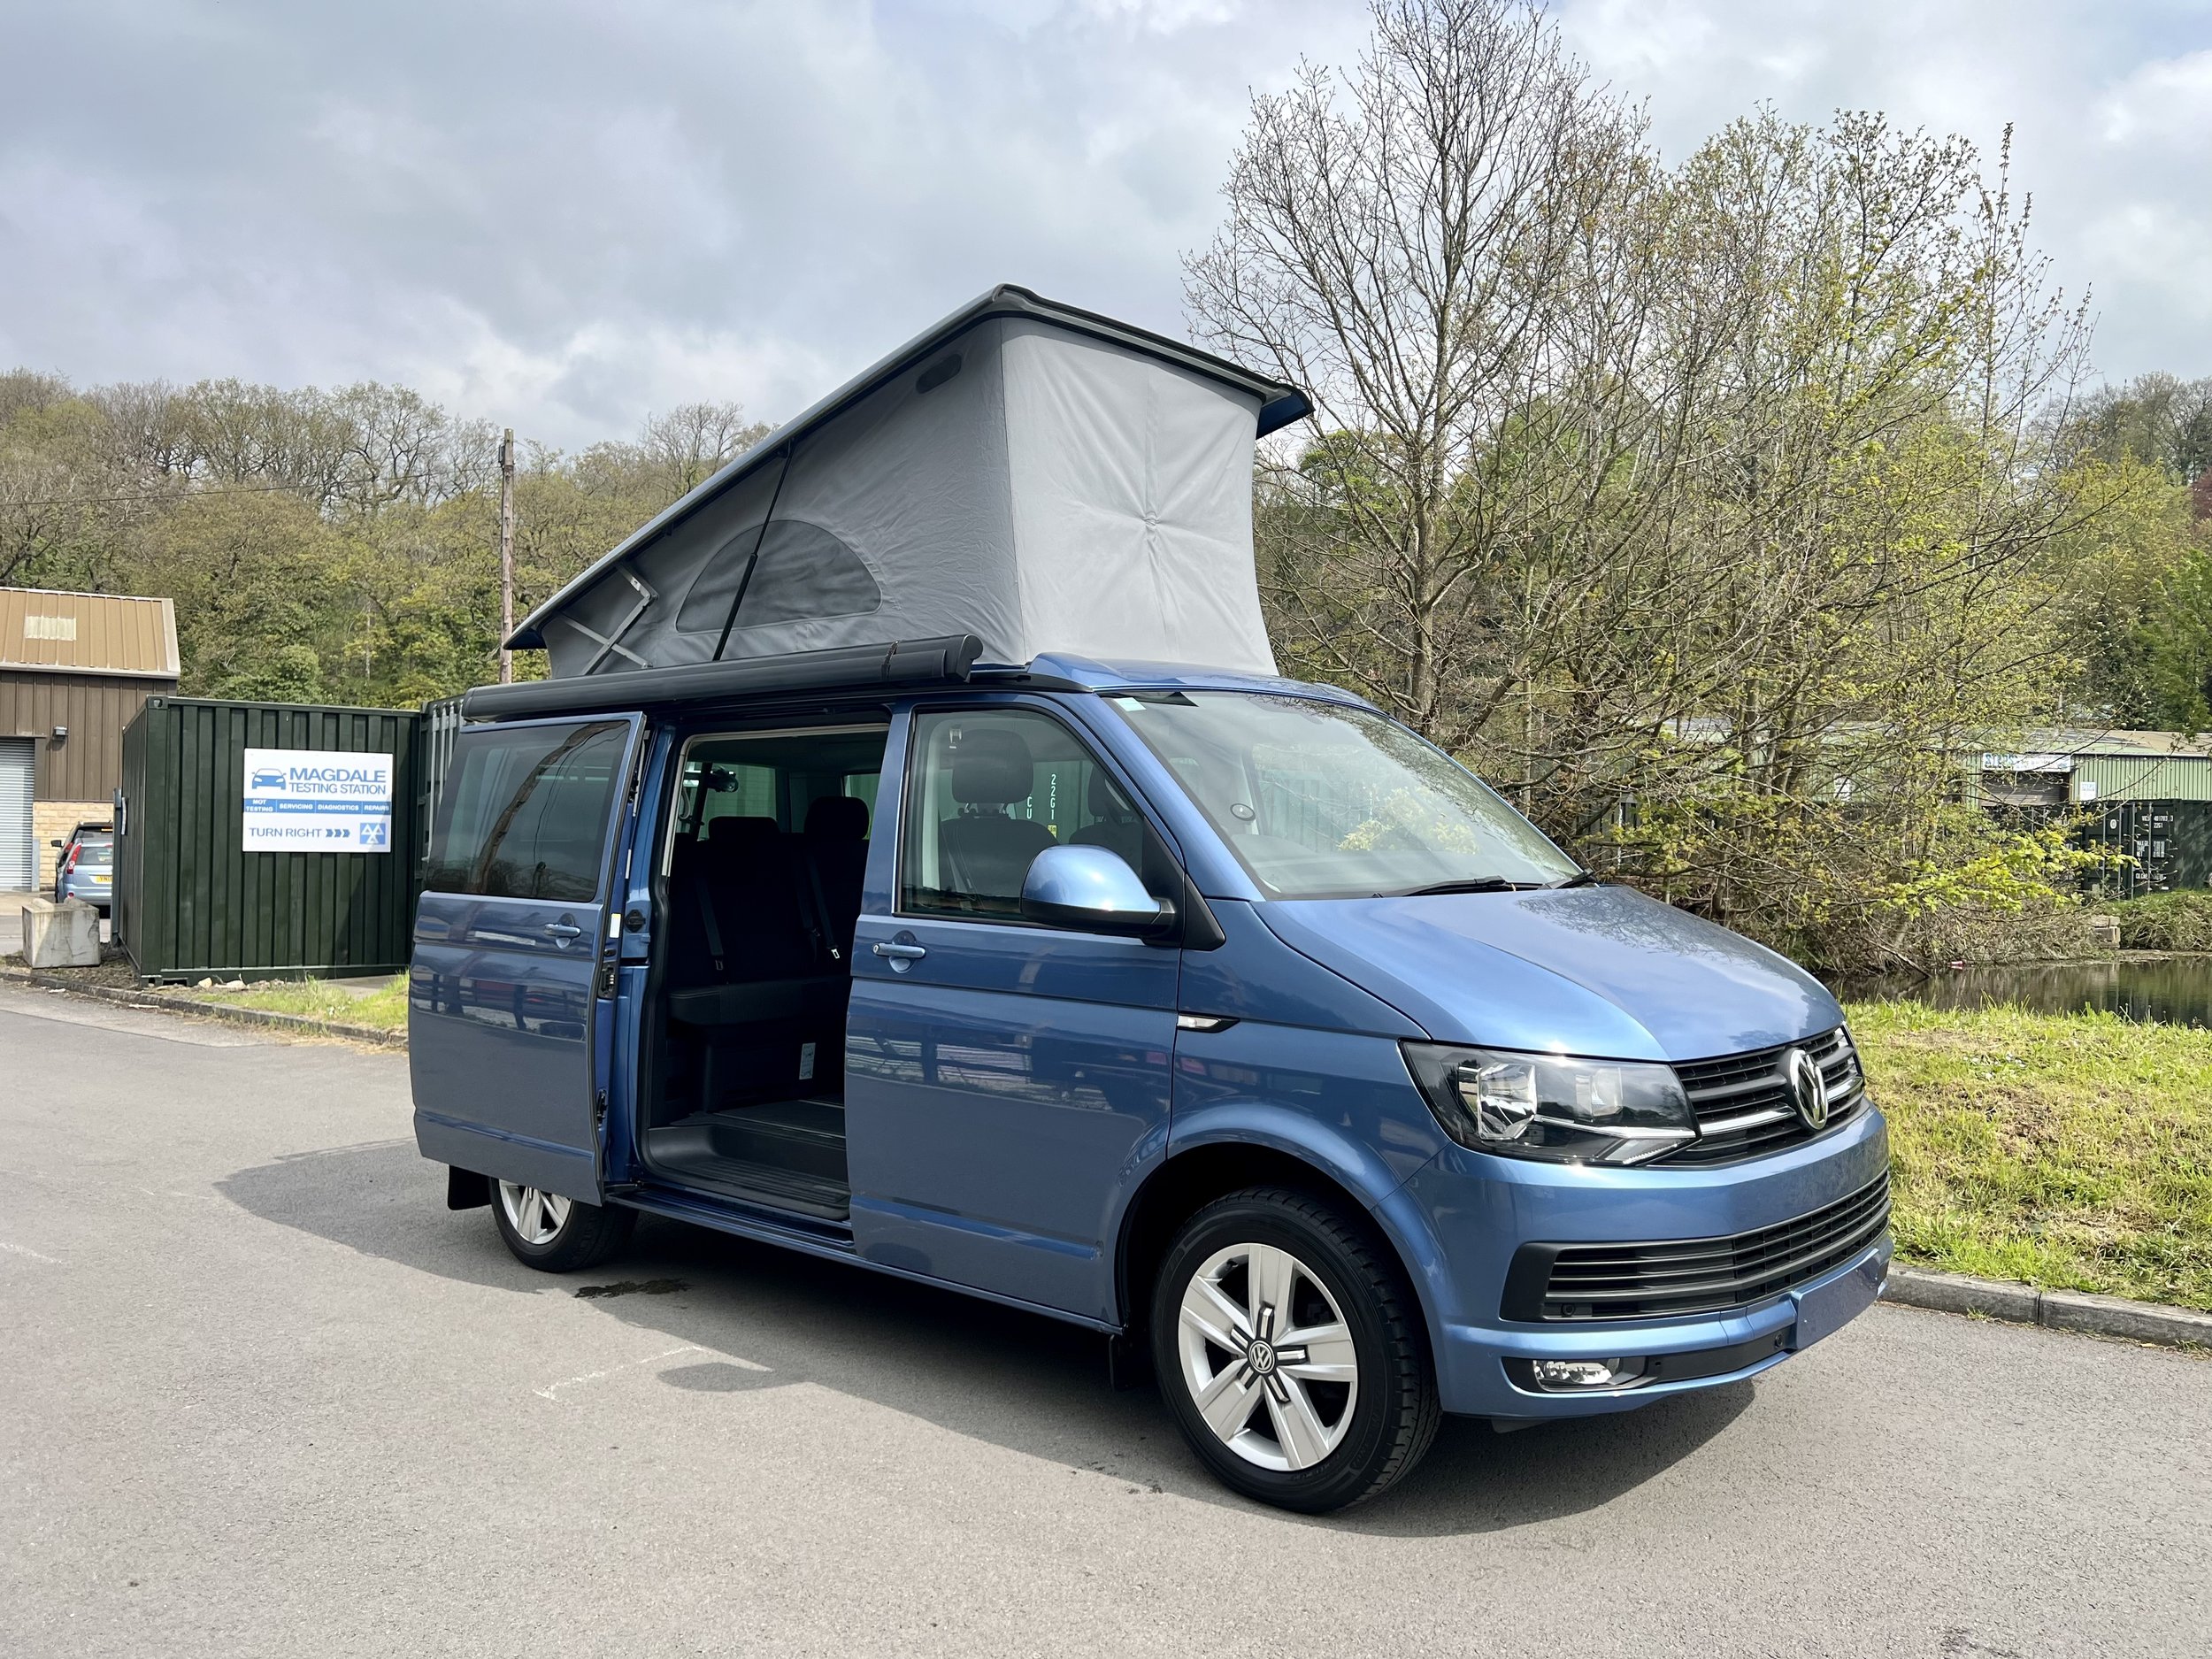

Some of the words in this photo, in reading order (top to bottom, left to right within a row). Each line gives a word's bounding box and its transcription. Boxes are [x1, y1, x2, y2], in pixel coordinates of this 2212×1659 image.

[289, 767, 387, 783] MAGDALE
[289, 782, 338, 794] TESTING
[340, 783, 387, 795] STATION
[249, 827, 283, 838] TURN
[285, 828, 322, 838] RIGHT
